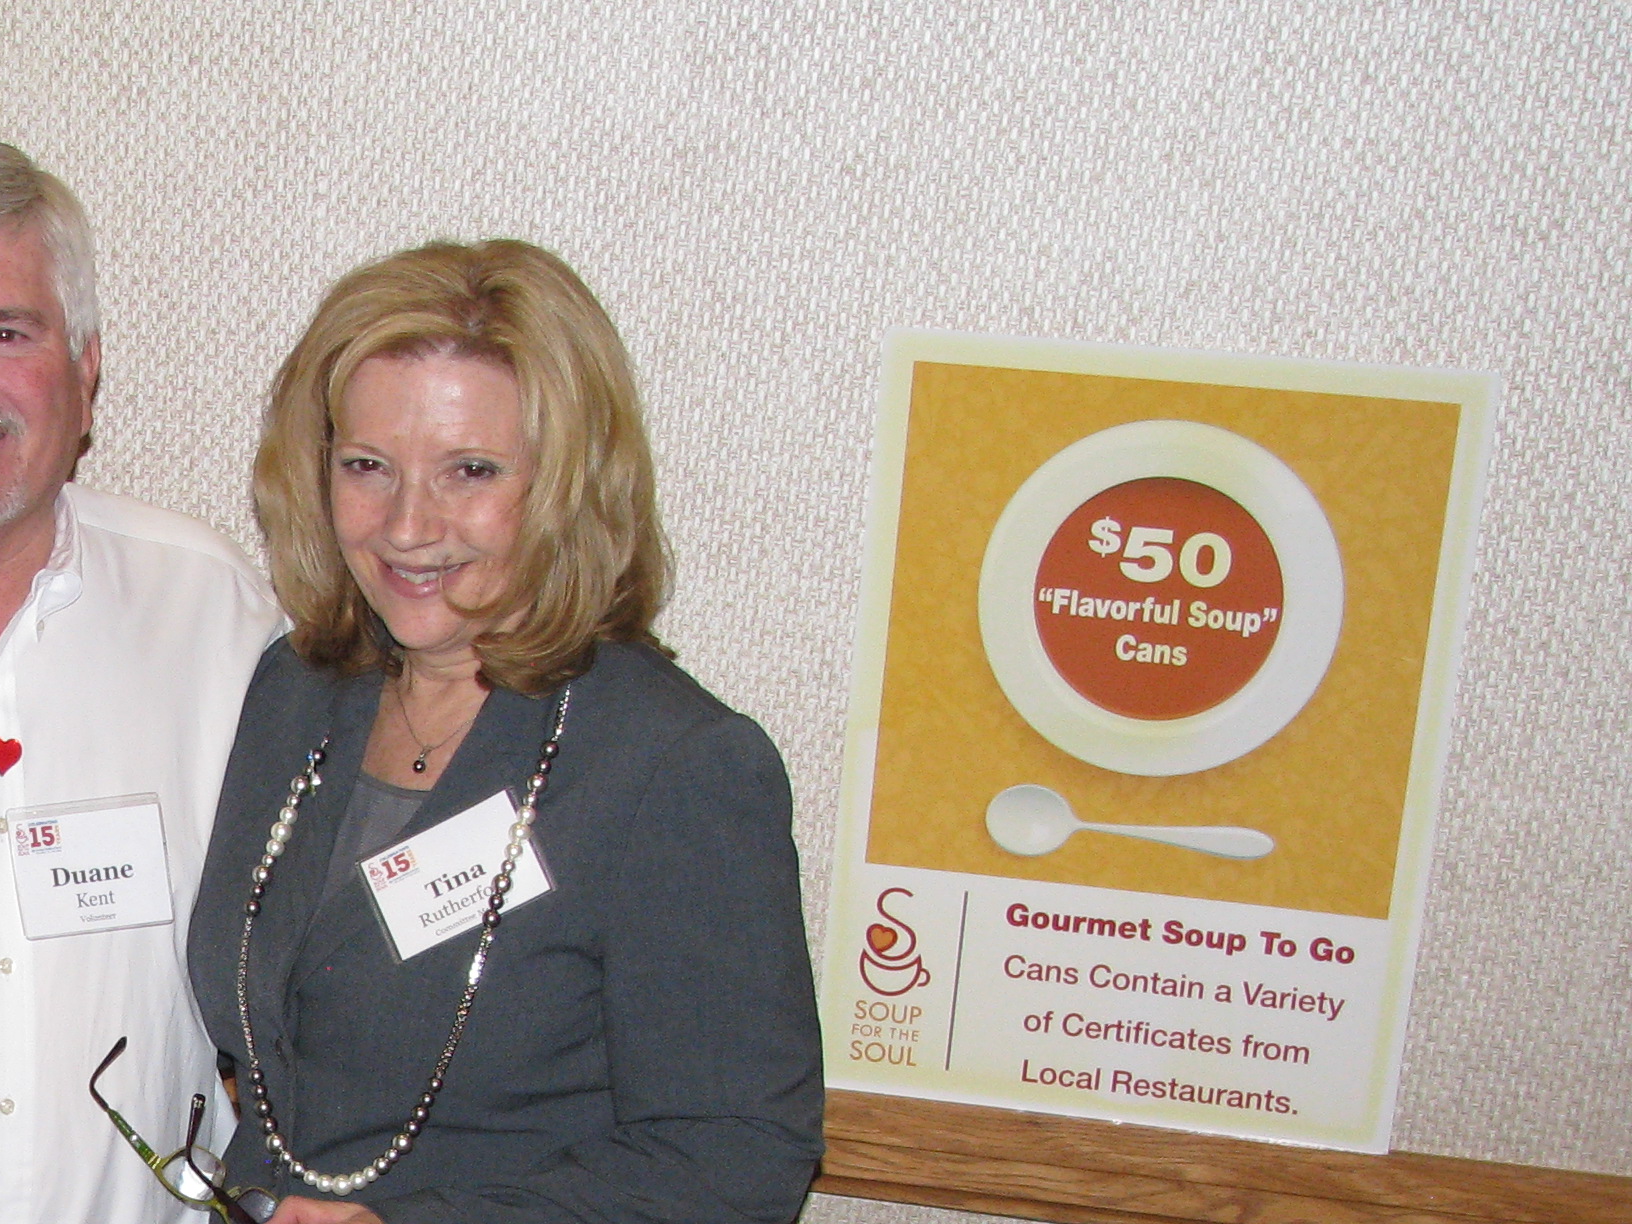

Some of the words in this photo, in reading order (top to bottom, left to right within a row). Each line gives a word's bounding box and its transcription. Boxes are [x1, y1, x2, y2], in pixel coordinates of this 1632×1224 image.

[1088, 516, 1232, 588] $50
[1039, 587, 1180, 627] “Flavorful
[1188, 600, 1276, 638] Soup”
[1115, 635, 1187, 667] Cans
[29, 826, 55, 848] 15
[50, 864, 134, 887] Duane
[382, 853, 410, 879] 15
[424, 863, 487, 899] Tina
[76, 891, 116, 908] Kent
[419, 885, 494, 928] Rutherfo
[1006, 903, 1151, 944] Gourmet
[1162, 920, 1247, 961] Soup
[1259, 930, 1296, 960] To
[1309, 935, 1354, 964] Go
[1004, 954, 1078, 985] Cans
[1089, 964, 1204, 998] Contain
[1216, 984, 1231, 1003] a
[1243, 981, 1345, 1021] Variety
[854, 1000, 921, 1024] SOUP
[852, 1024, 881, 1037] FOR
[890, 1027, 920, 1042] THE
[1023, 1010, 1056, 1033] of
[1063, 1013, 1231, 1058] Certificates
[1241, 1034, 1310, 1065] from
[850, 1040, 916, 1066] SOUL
[1020, 1059, 1101, 1091] Local
[1111, 1070, 1298, 1116] Restaurants.
